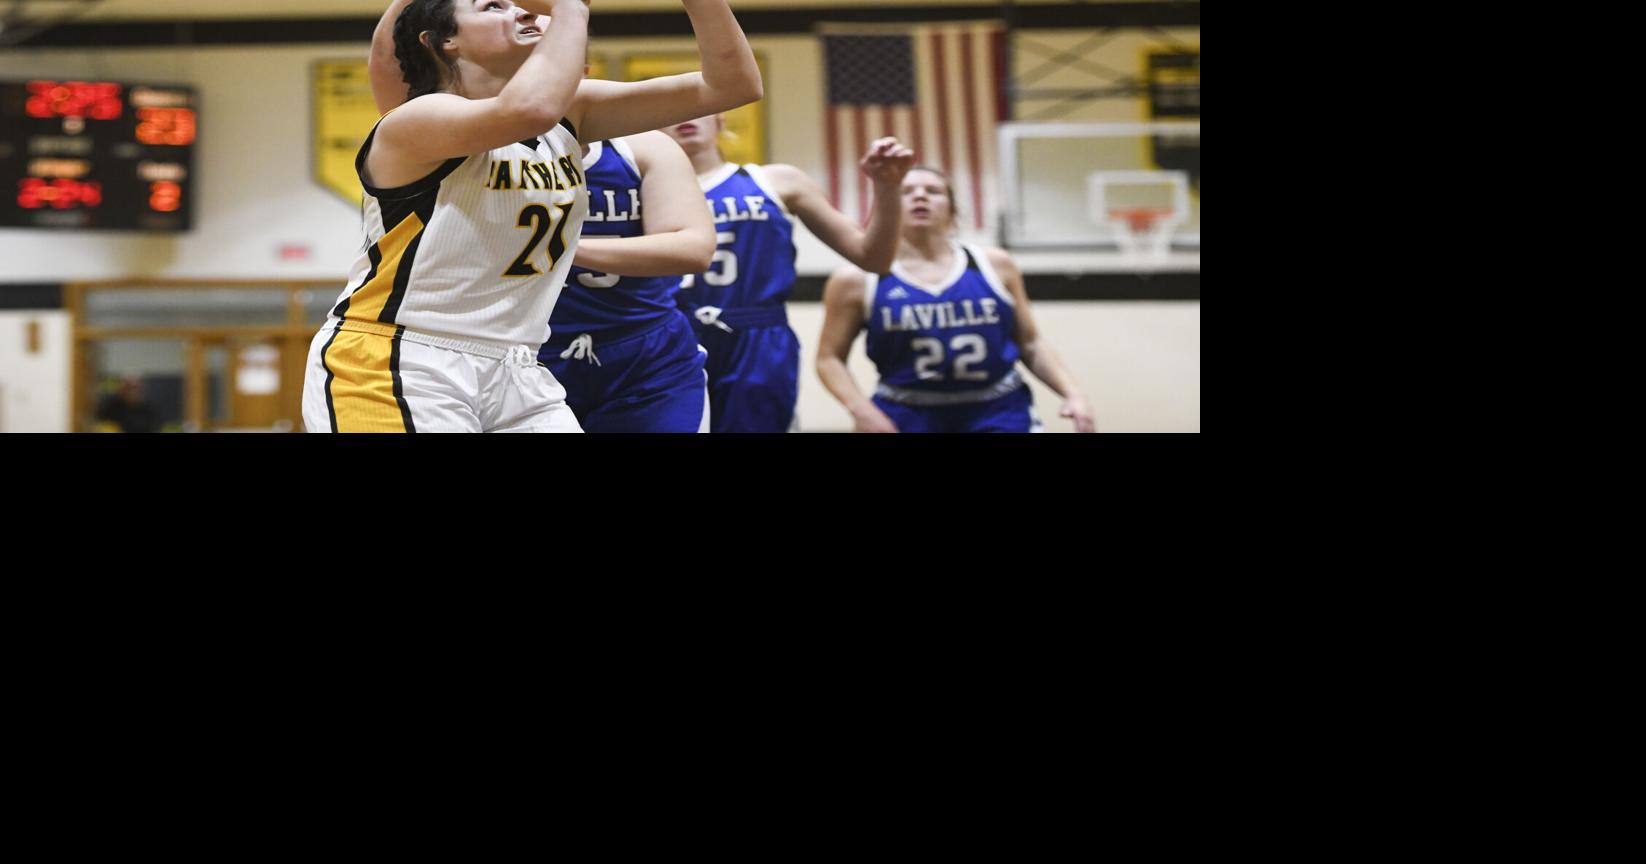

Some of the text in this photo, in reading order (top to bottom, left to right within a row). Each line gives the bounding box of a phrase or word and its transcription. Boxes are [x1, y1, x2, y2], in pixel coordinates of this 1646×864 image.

[501, 202, 575, 277] 21
[881, 298, 999, 331] LAVILLE
[911, 333, 989, 381] 22
